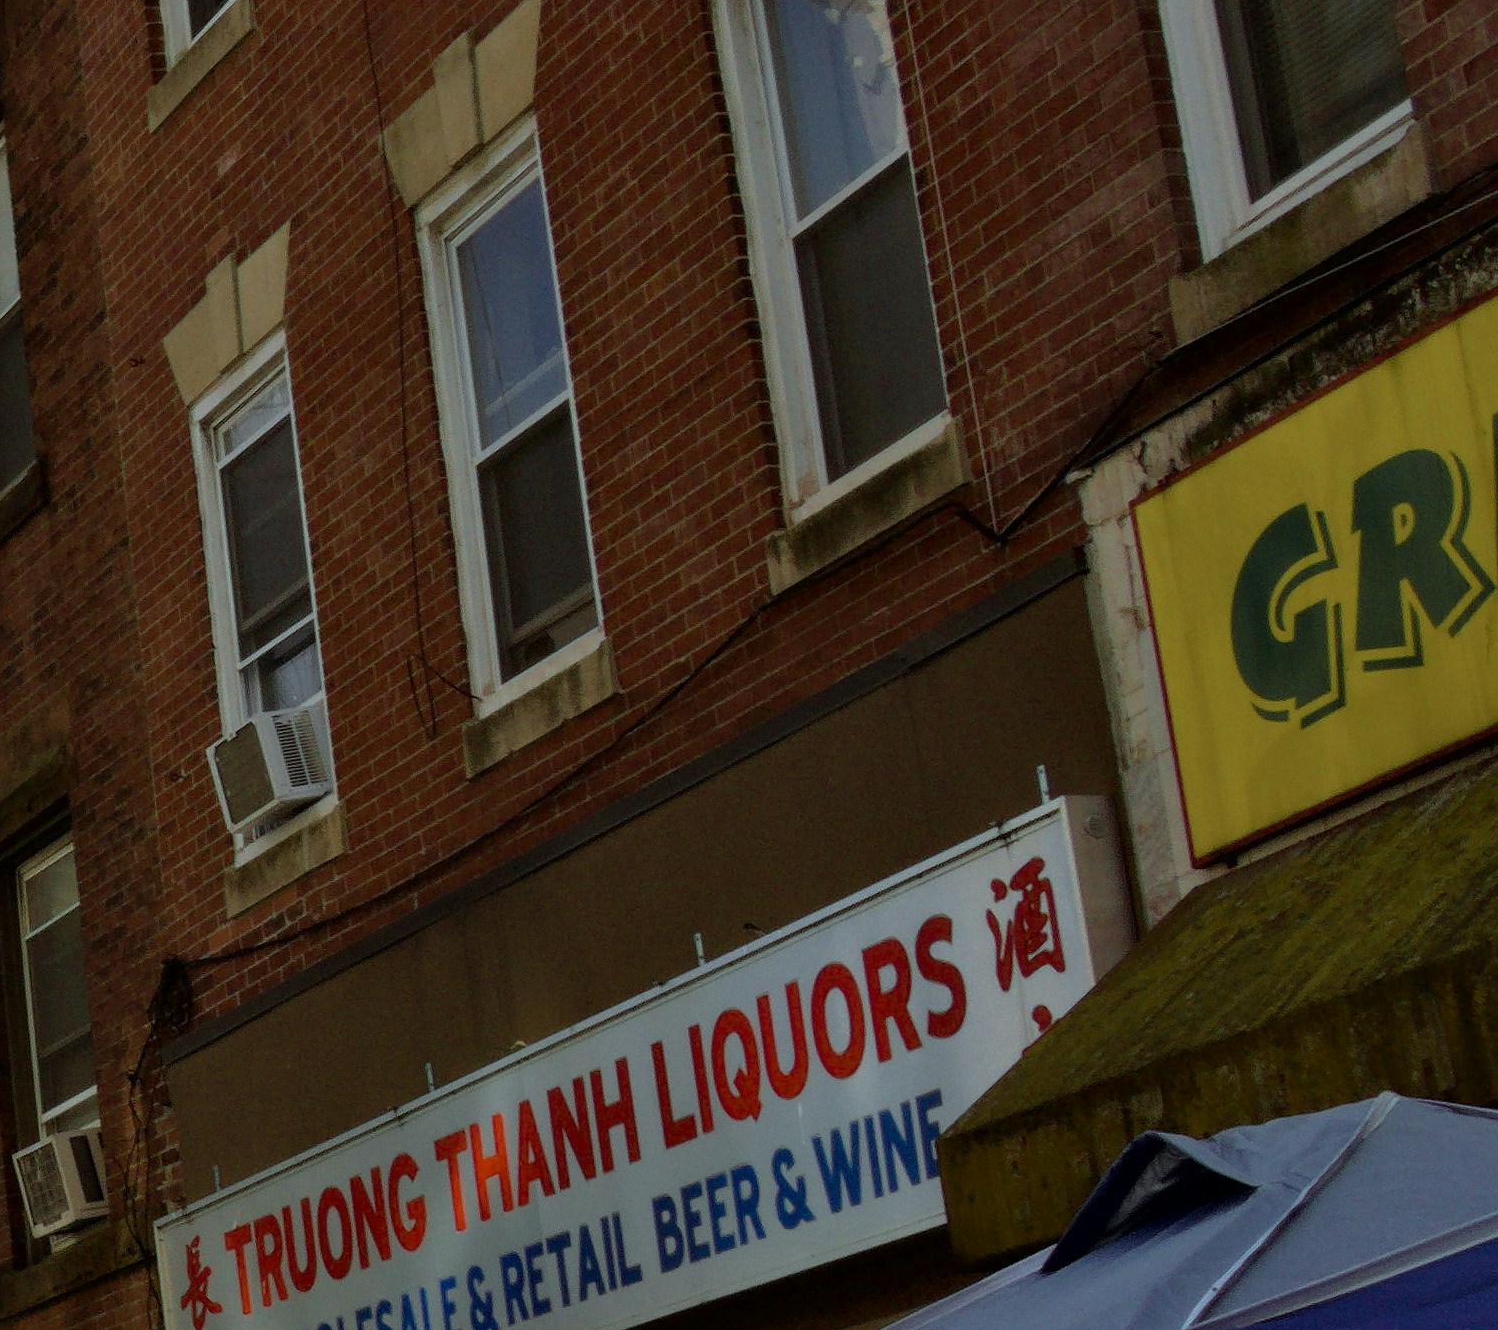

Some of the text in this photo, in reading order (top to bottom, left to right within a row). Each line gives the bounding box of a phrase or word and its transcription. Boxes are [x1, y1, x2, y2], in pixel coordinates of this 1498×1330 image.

[1229, 414, 1498, 729] GR
[986, 857, 1066, 1034] 酒
[225, 915, 967, 1316] TRUONG THANH LIQUORS
[498, 1212, 643, 1325] RETAIL
[651, 1161, 765, 1273] BEER
[772, 1148, 816, 1228] &
[811, 1087, 944, 1214] WINE
